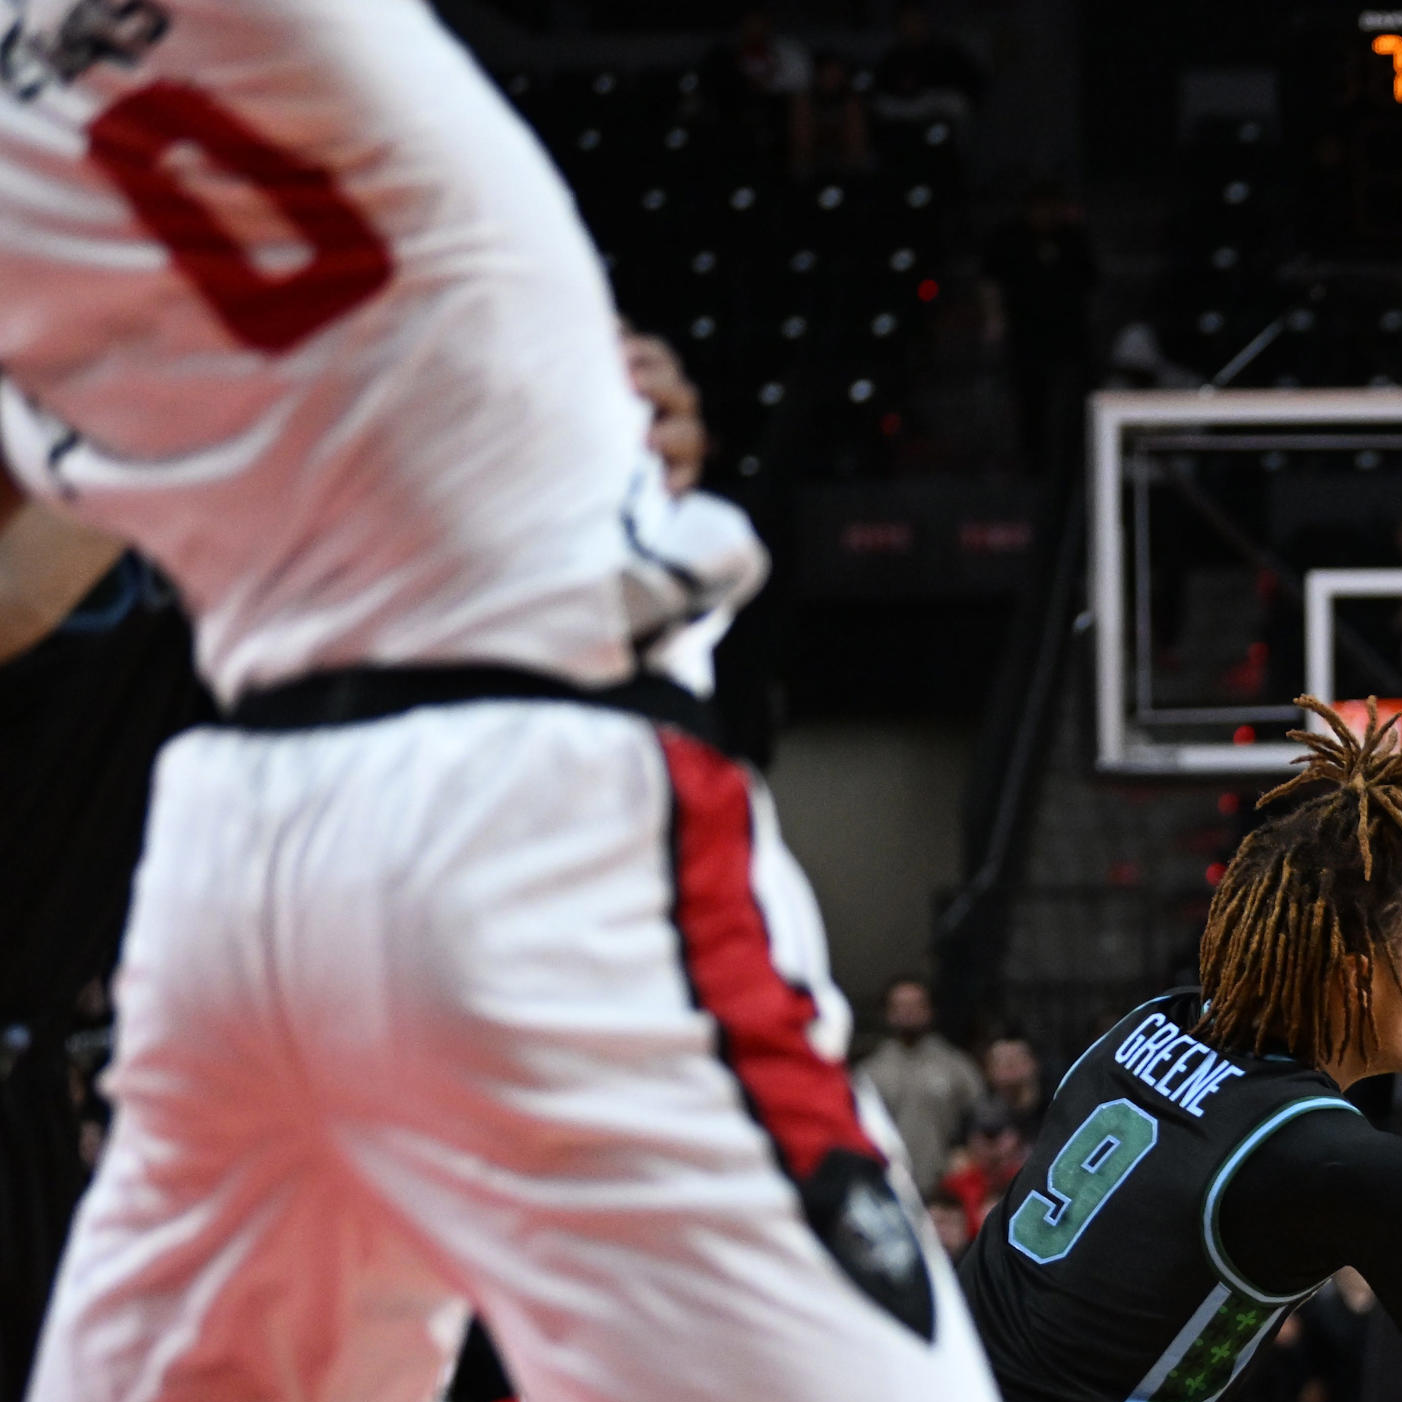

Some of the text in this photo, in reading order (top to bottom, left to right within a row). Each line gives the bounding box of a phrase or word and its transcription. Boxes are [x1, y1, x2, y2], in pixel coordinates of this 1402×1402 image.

[84, 76, 396, 359] 0
[1113, 1012, 1246, 1118] GREENE
[1008, 1097, 1159, 1265] 9
